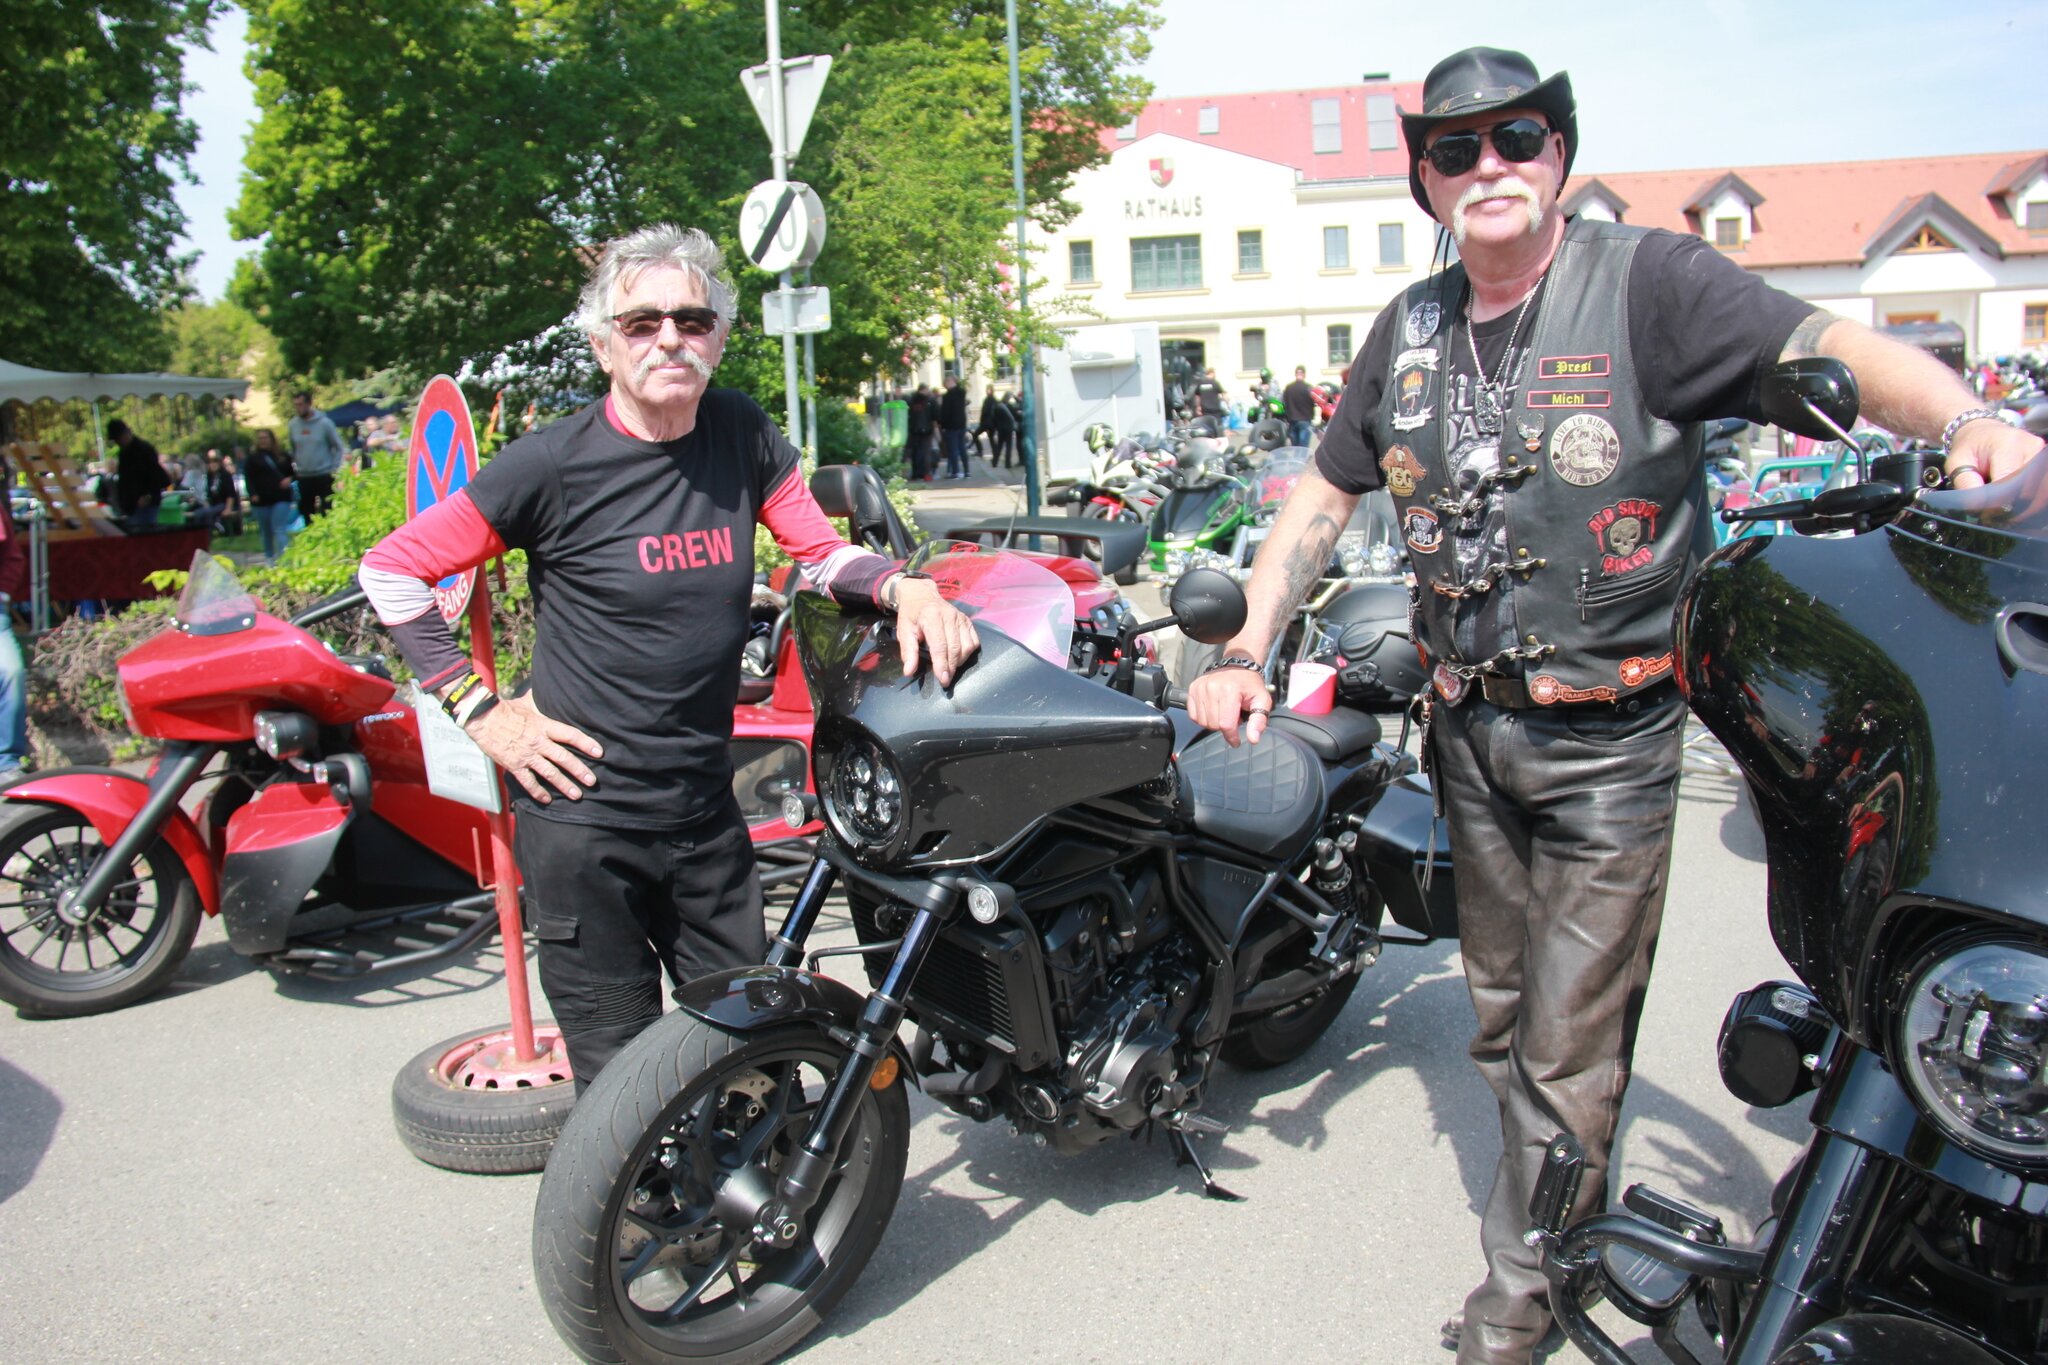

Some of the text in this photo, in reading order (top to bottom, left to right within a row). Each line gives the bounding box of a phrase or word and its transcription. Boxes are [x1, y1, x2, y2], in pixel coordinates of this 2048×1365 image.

[1124, 195, 1203, 221] RATHAUS
[1555, 360, 1592, 375] Presi
[1554, 416, 1608, 443] LIVE TO RIDE
[1561, 457, 1616, 484] RIDE TO LIVE
[1588, 507, 1615, 532] OLD
[638, 526, 734, 574] CREW
[1603, 546, 1653, 576] BIKER
